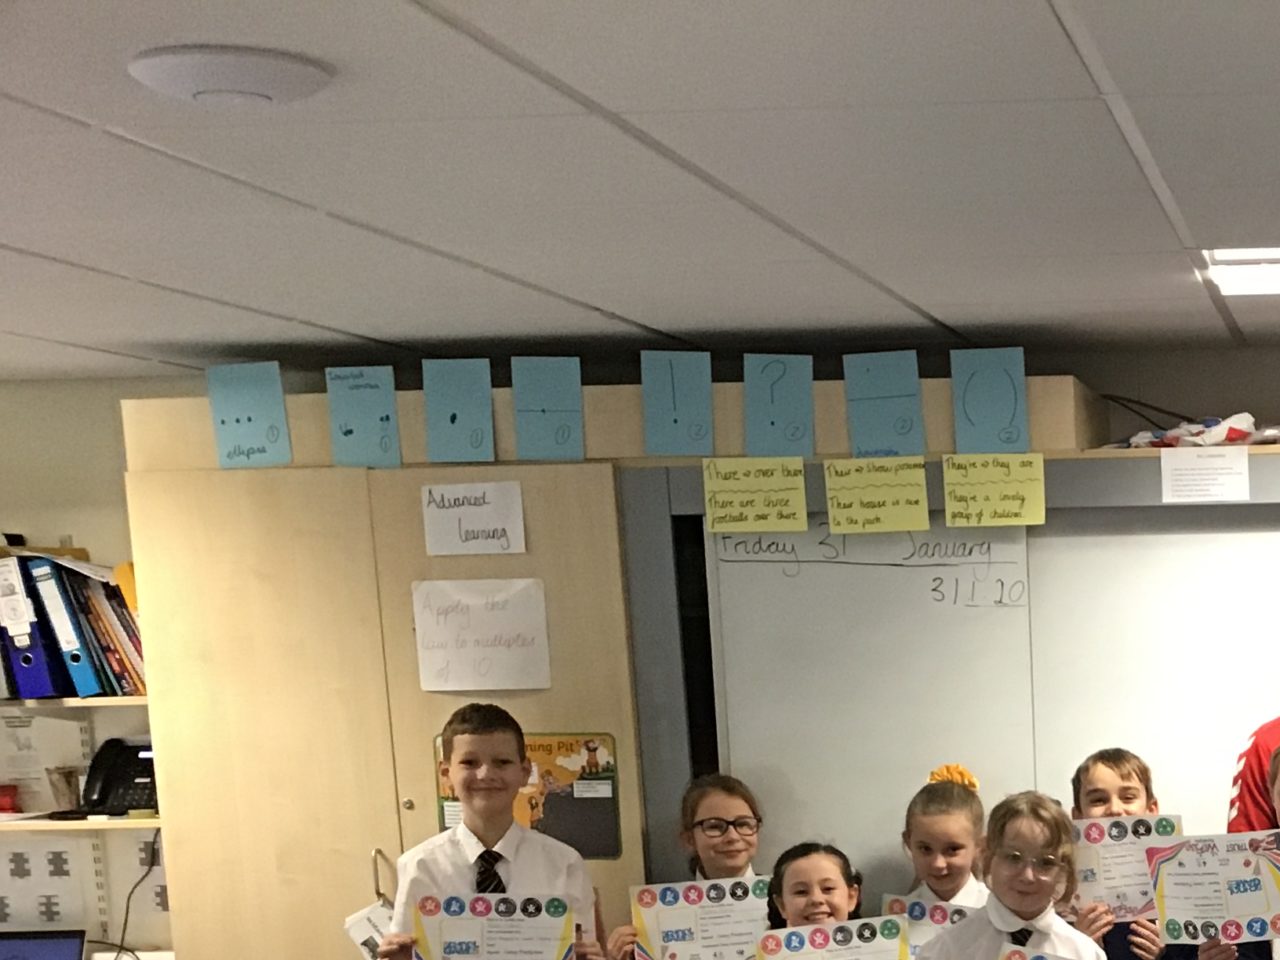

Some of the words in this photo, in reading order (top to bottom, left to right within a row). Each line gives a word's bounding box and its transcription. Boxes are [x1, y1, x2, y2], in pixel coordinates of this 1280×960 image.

[1019, 460, 1034, 468] are
[426, 487, 492, 509] Advanced
[708, 491, 735, 509] There
[739, 499, 756, 508] are
[763, 495, 790, 508] three
[832, 514, 842, 527] to
[720, 534, 800, 577] Friday
[817, 521, 848, 560] 31
[901, 530, 992, 580] January
